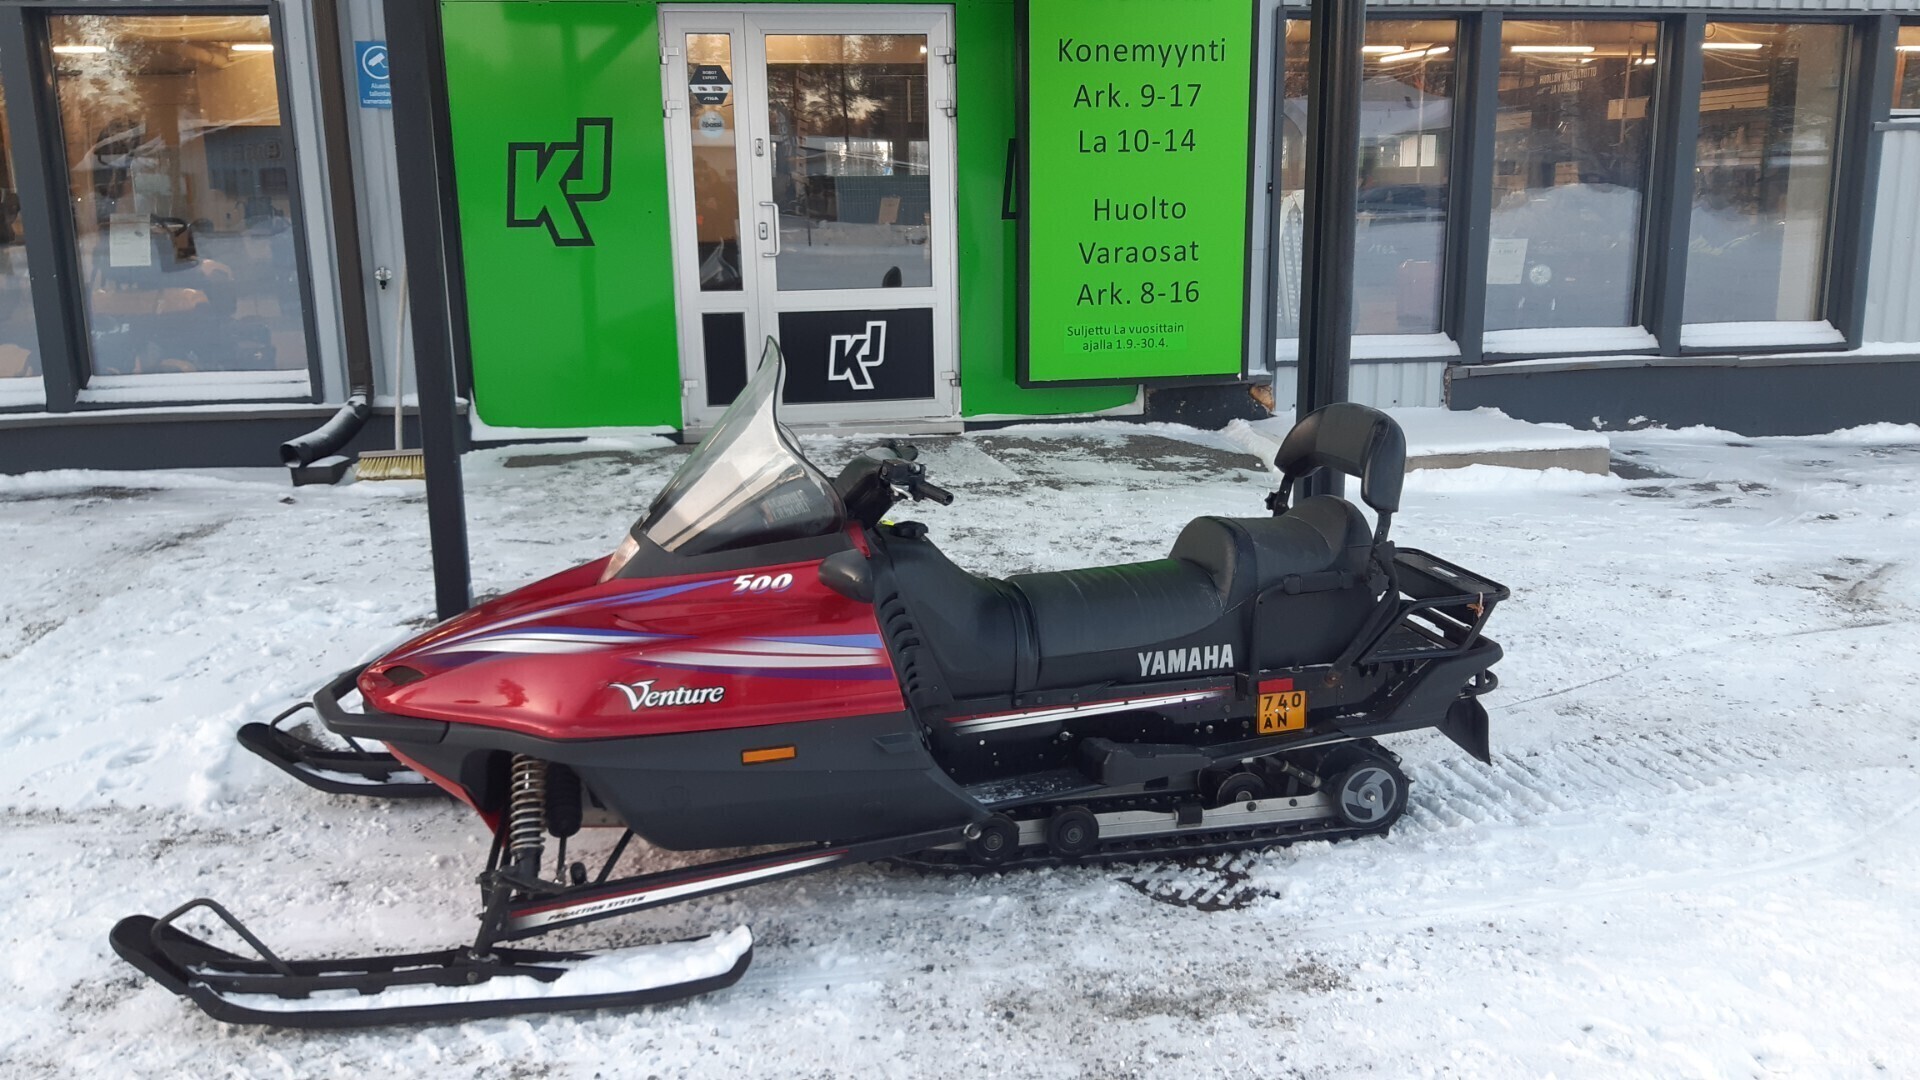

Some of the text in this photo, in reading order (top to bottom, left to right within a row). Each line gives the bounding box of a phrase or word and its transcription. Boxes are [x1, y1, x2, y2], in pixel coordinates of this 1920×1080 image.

[1058, 38, 1226, 67] Konemyynti
[1073, 83, 1202, 108] Ark. 9-17
[1079, 129, 1196, 153] La 10-14
[507, 117, 613, 246] KJ
[1094, 196, 1187, 221] Huolto
[1078, 241, 1199, 265] Varaosat
[1076, 281, 1200, 306] Ark. 8-16
[1067, 322, 1184, 338] Suljettu La vuosittain
[828, 320, 887, 390] KJ
[1082, 338, 1169, 352] ajalla 1.9.-30.4.
[732, 573, 793, 595] 500
[1138, 644, 1234, 677] YAMAHA
[607, 679, 726, 712] Venture
[1263, 692, 1302, 712] 740
[1263, 711, 1288, 730] ÄN
[547, 896, 646, 921] PROACTION SYSTEM
